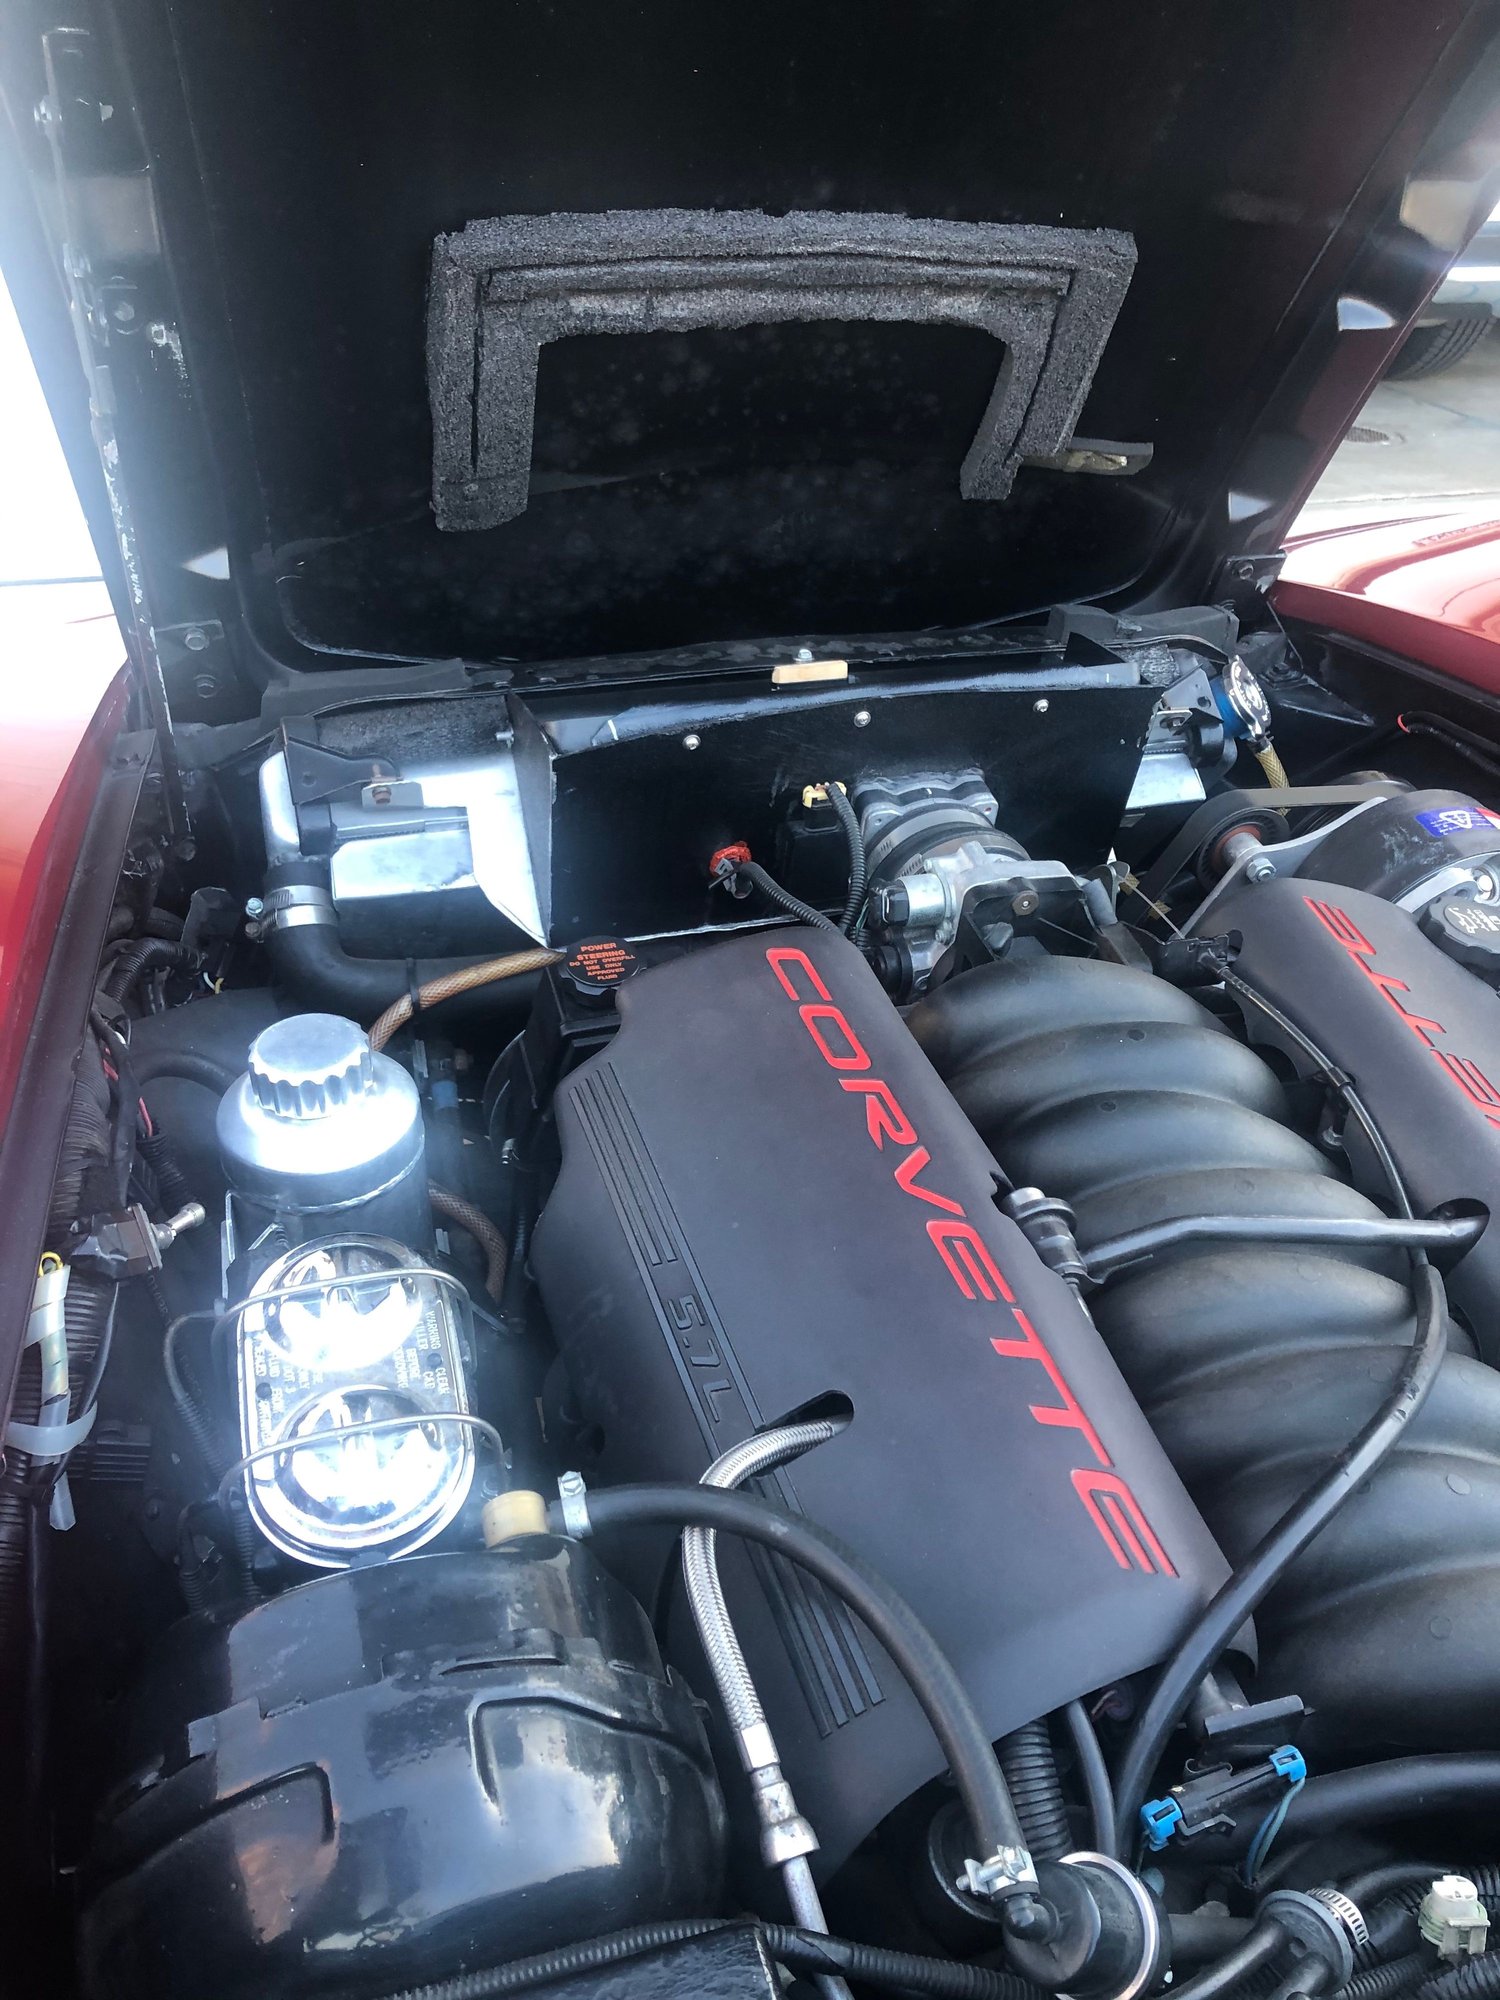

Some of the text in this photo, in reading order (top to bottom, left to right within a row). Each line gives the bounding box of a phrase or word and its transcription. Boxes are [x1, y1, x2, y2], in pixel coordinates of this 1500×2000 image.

[581, 943, 616, 952] POWER
[577, 950, 625, 960] STEERING
[602, 955, 635, 963] OVERFILL
[587, 968, 625, 976] APPROVED
[1303, 896, 1500, 1130] ETTE
[766, 947, 1180, 1579] CORVETTE
[668, 1294, 732, 1423] 5.7L
